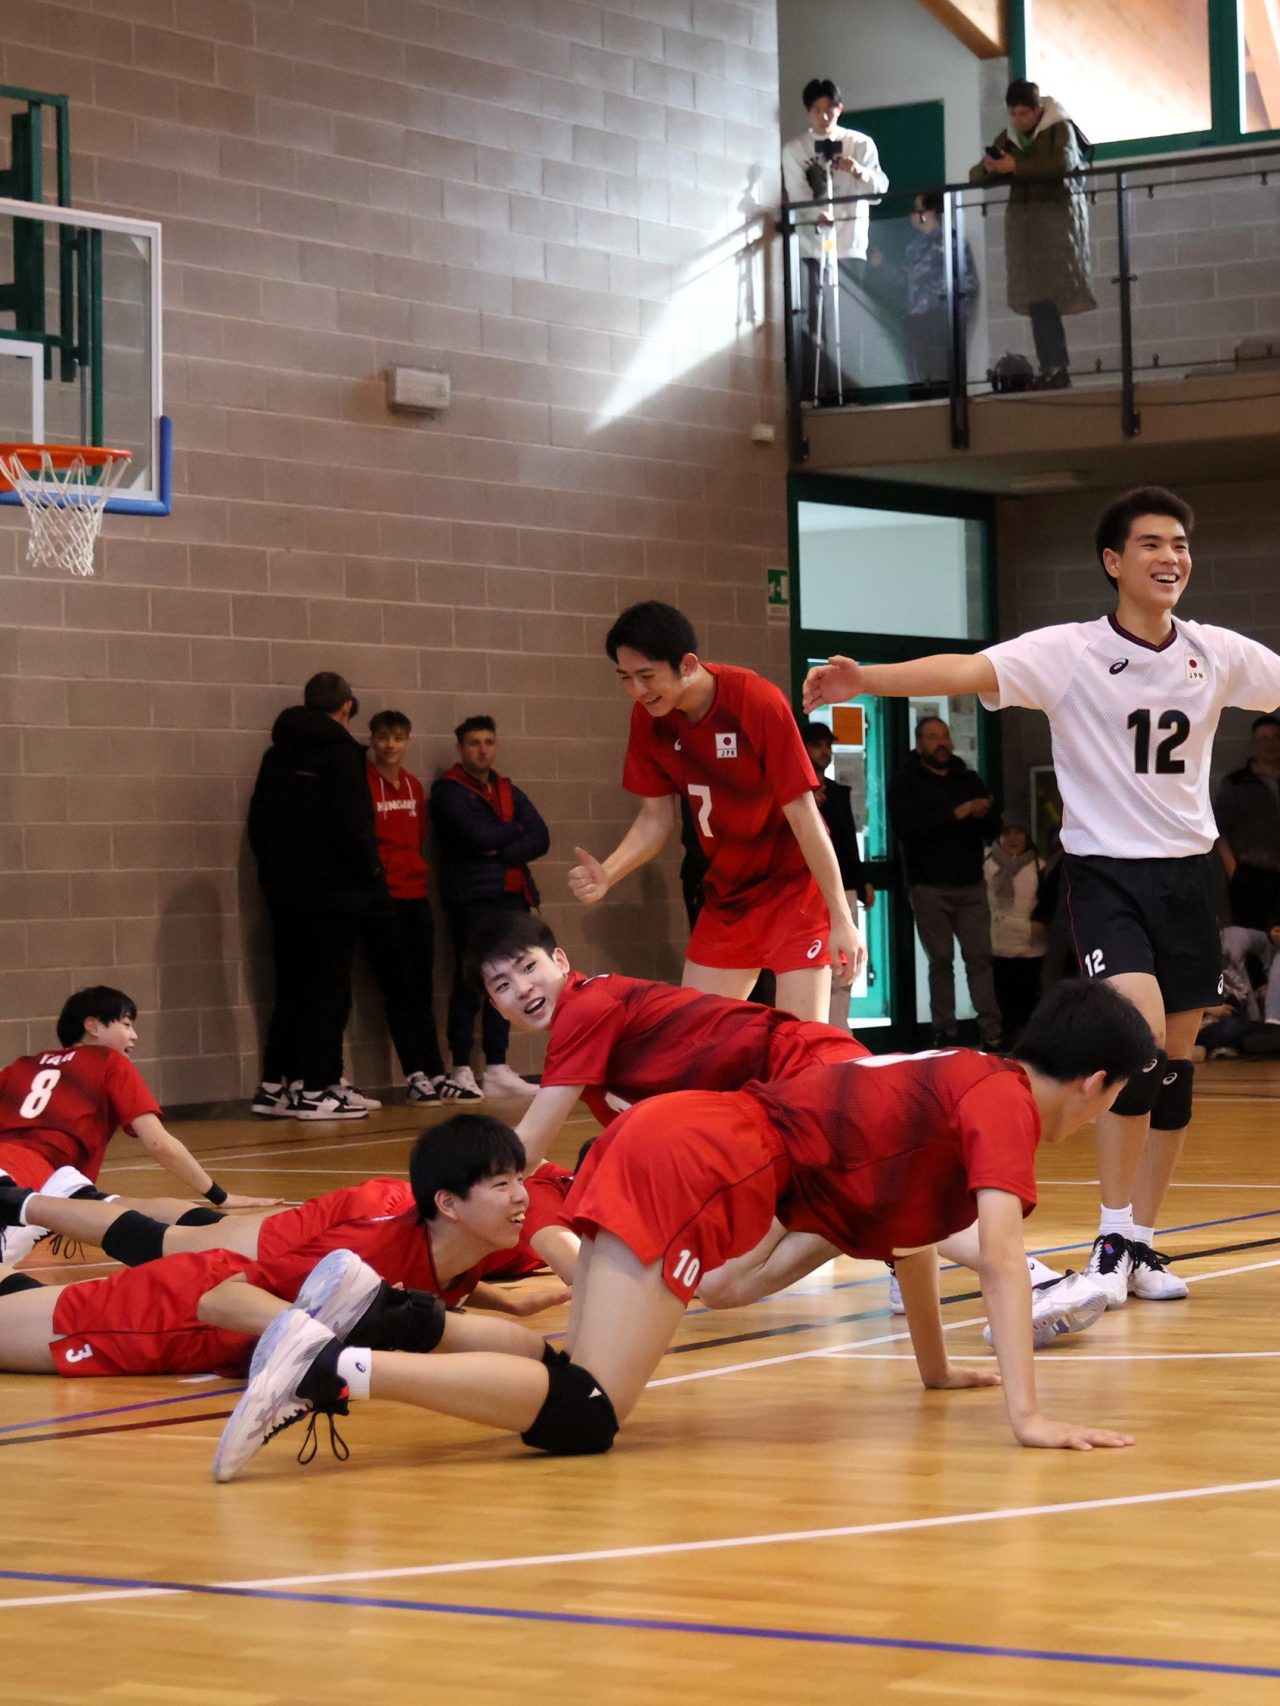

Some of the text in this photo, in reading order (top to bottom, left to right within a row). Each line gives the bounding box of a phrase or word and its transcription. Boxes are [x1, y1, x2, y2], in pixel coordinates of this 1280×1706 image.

[1127, 708, 1191, 774] 12
[687, 783, 714, 838] 7
[1084, 948, 1106, 978] 12
[19, 1068, 61, 1119] 8
[672, 1249, 701, 1287] 10
[65, 1343, 93, 1363] 3
